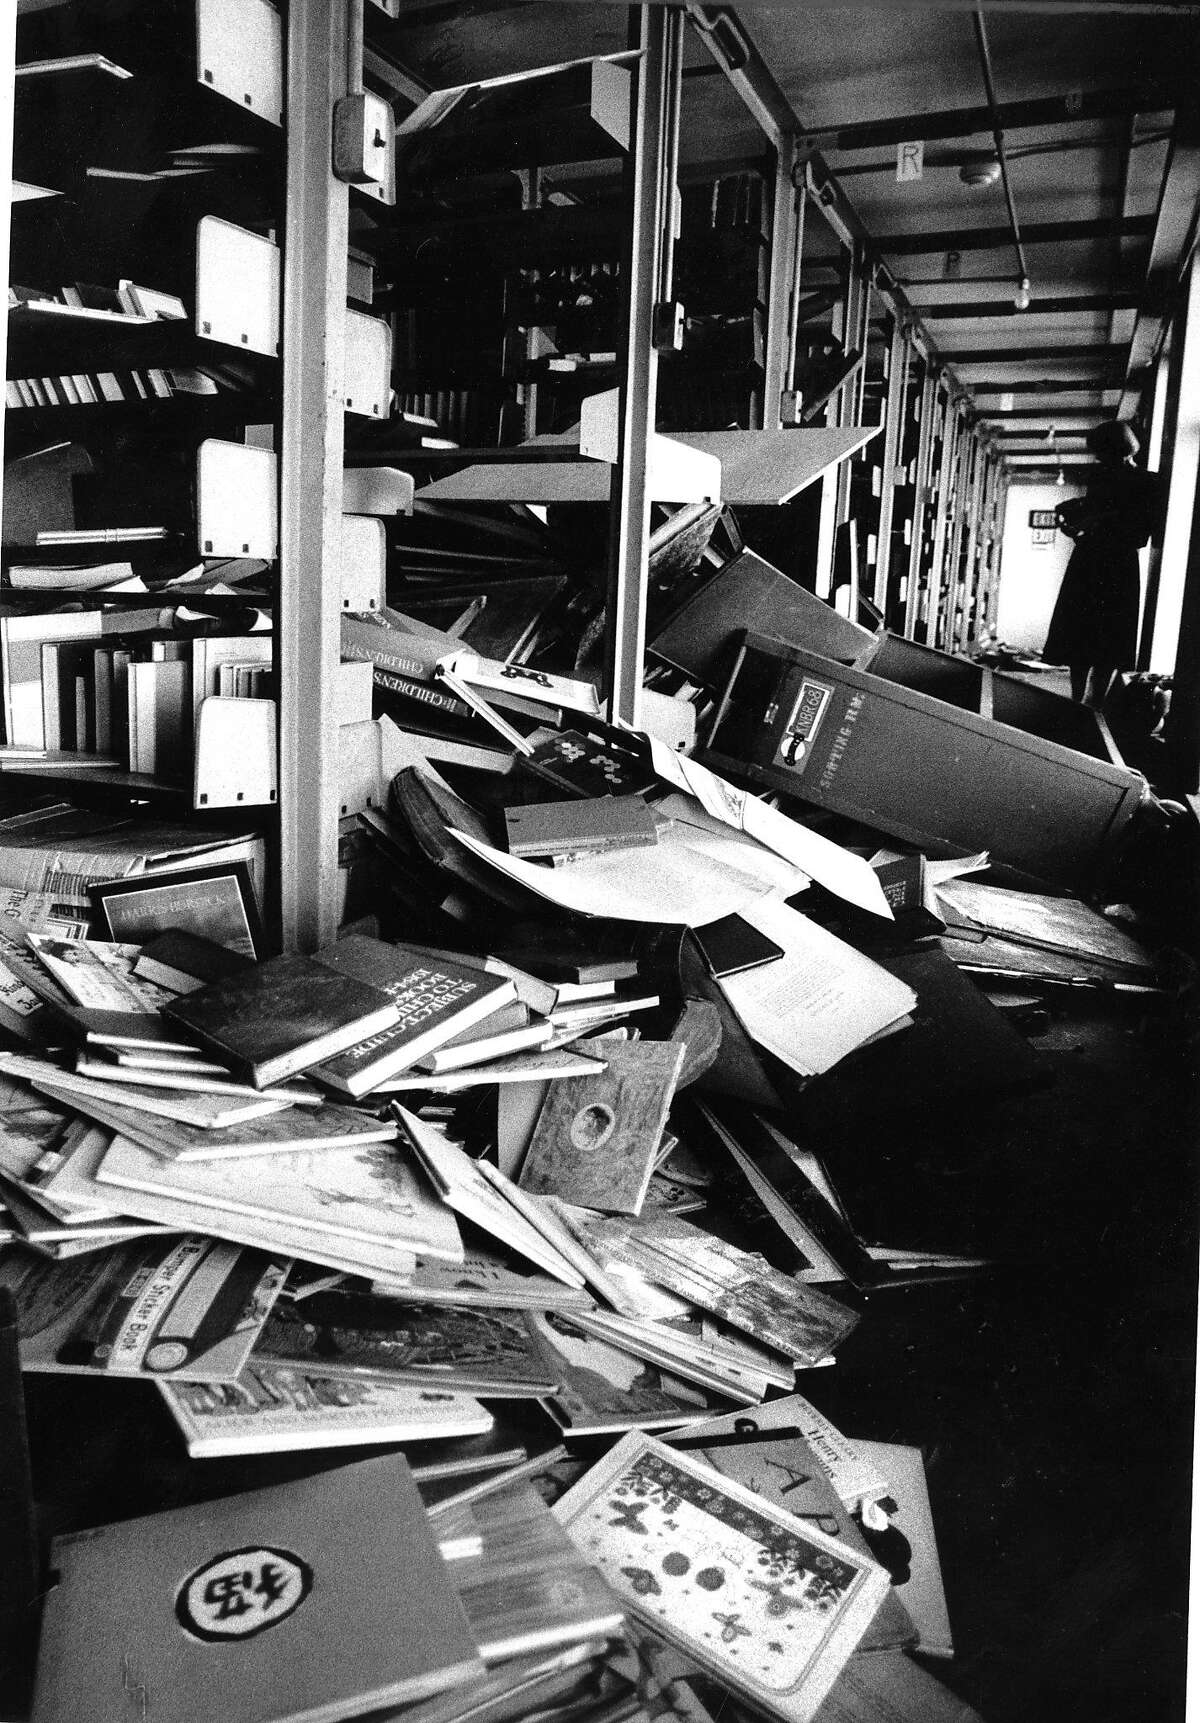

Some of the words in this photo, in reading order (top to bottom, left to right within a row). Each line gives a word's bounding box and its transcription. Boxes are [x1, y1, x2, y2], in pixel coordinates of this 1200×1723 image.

[373, 671, 443, 706] CHILDREN'S
[6, 890, 28, 908] The
[431, 979, 463, 994] TO
[401, 983, 477, 1025] SUBJECT
[806, 1429, 841, 1463] Henry
